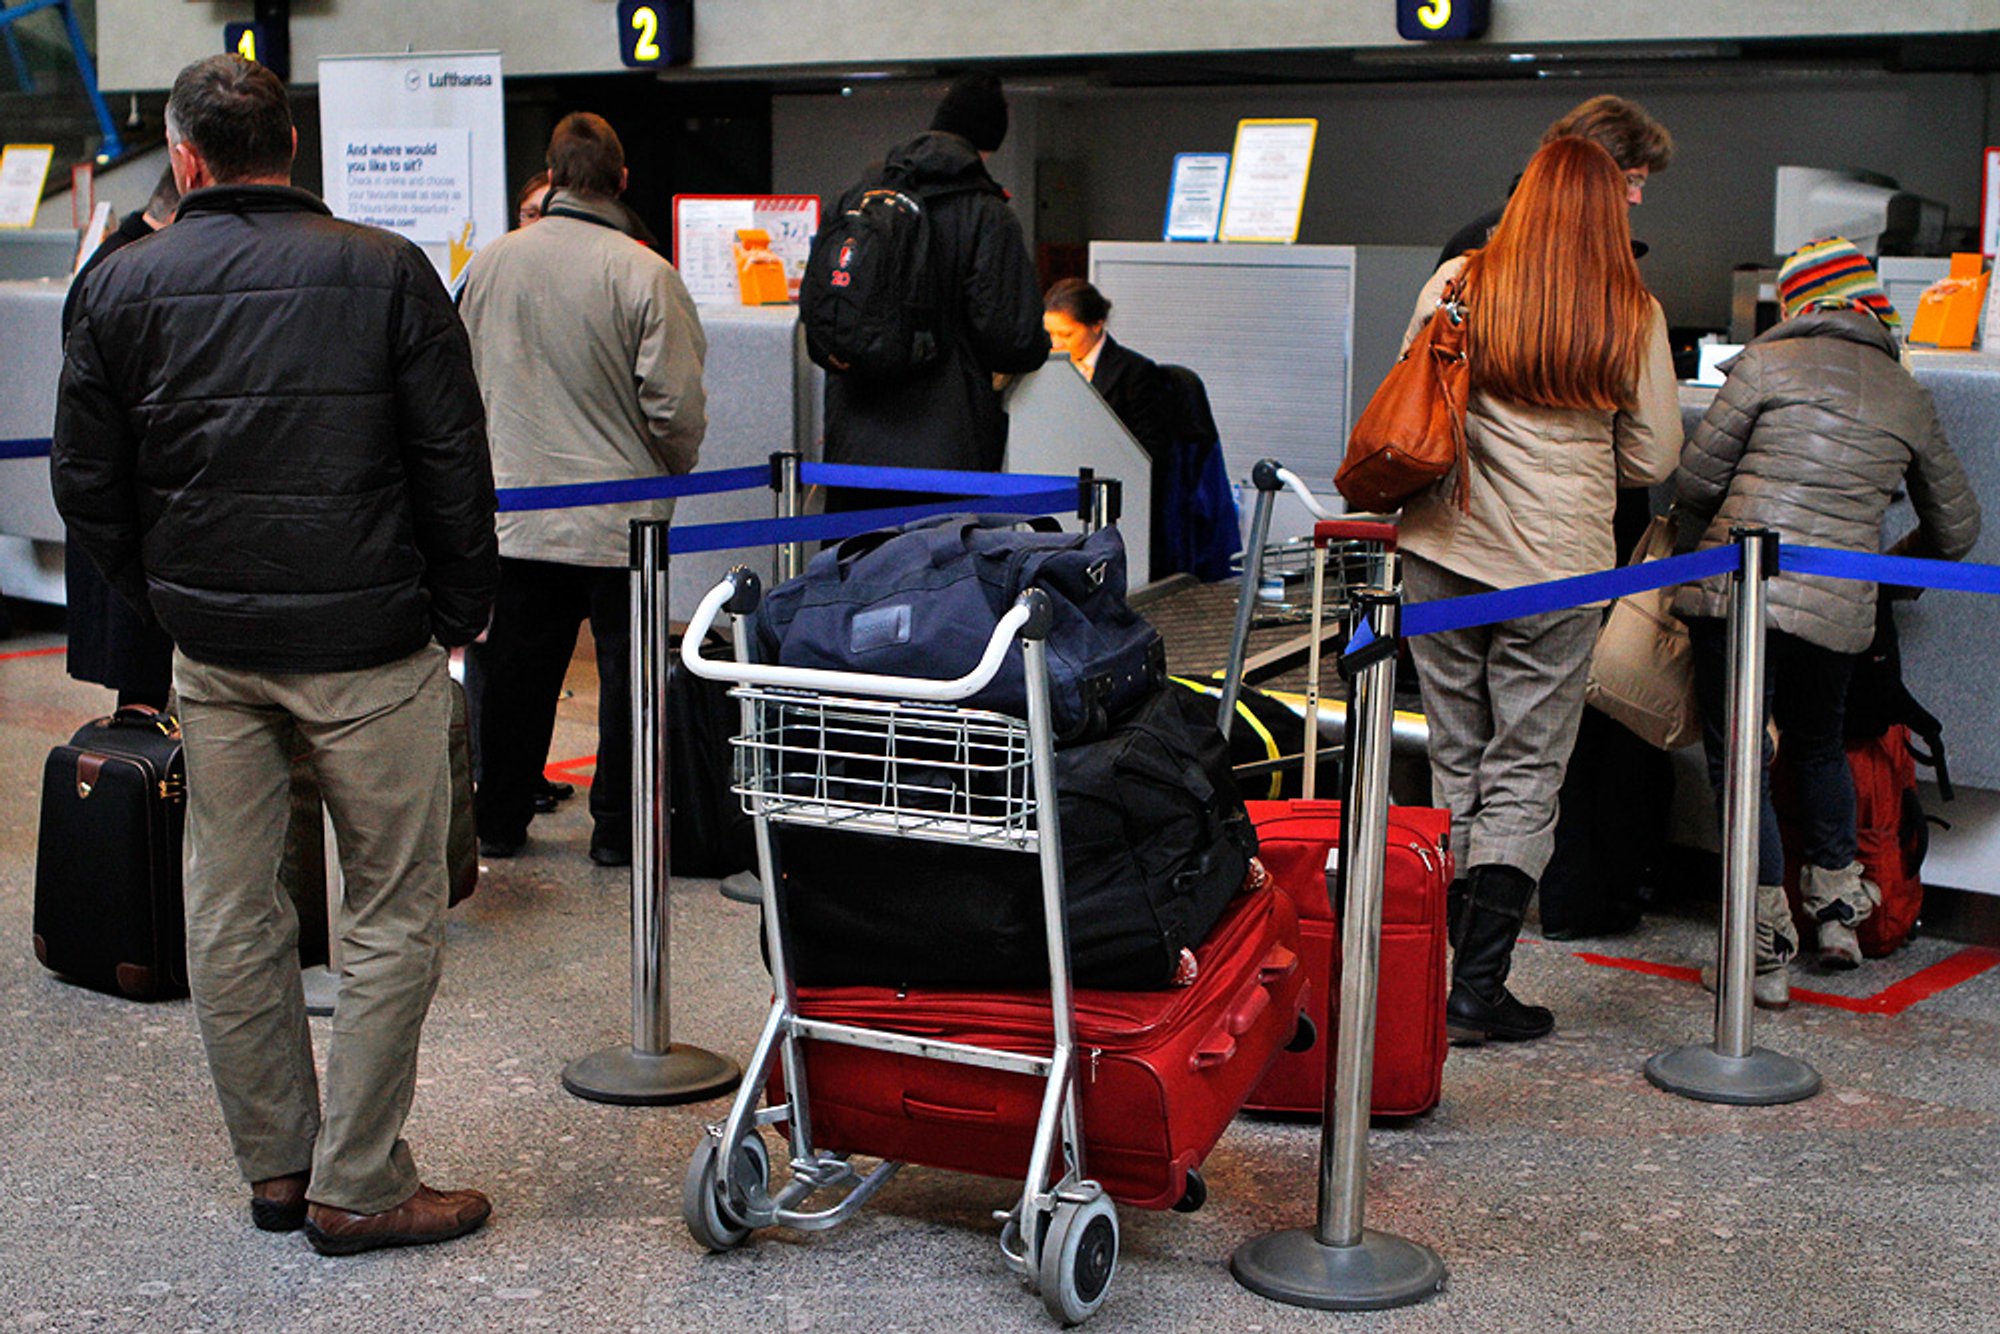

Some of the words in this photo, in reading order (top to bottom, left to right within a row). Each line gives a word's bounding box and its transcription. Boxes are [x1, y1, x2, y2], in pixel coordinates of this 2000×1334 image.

[631, 6, 660, 61] 2
[238, 29, 255, 61] 1
[428, 71, 492, 87] Lufthansa
[346, 143, 368, 156] And
[371, 144, 402, 156] where
[404, 142, 437, 155] would
[347, 161, 366, 173] you
[368, 159, 387, 172] like
[389, 160, 401, 171] to
[403, 158, 423, 171] sit?
